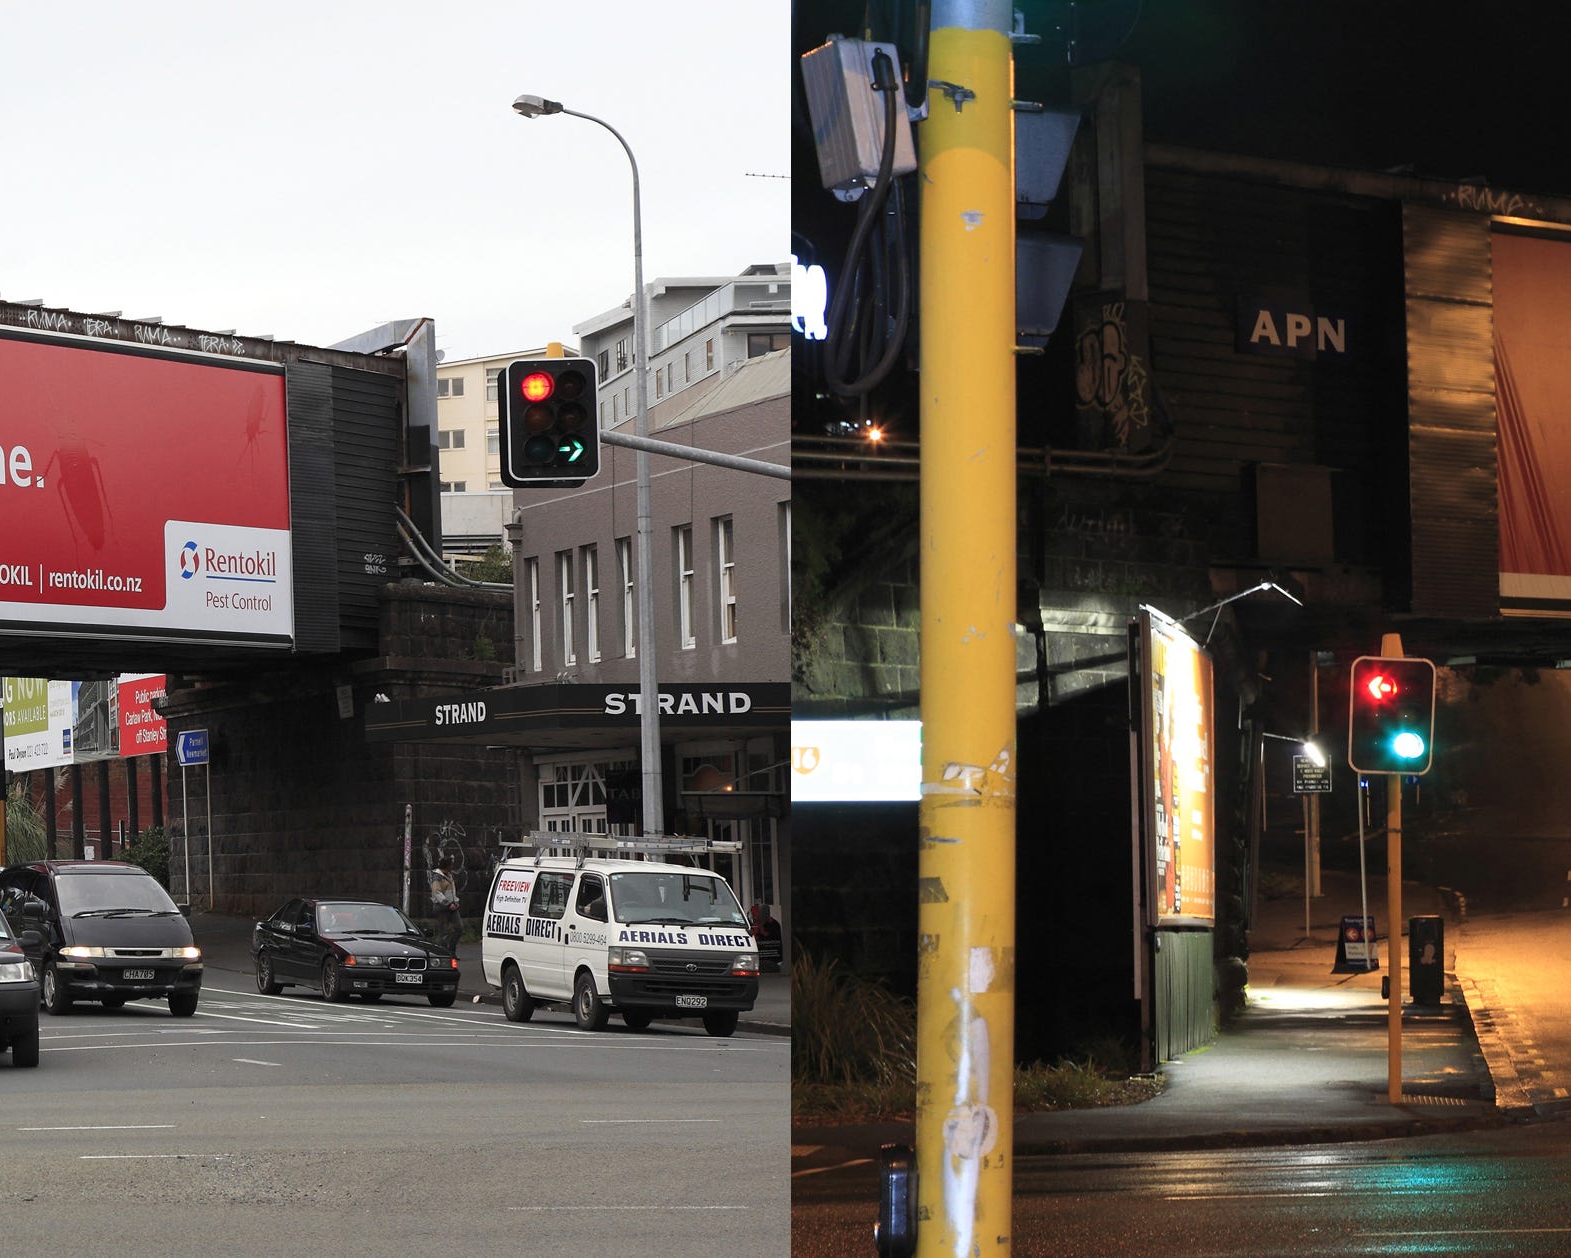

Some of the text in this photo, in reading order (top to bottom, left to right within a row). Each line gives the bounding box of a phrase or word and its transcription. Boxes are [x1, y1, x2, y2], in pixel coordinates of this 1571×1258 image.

[1250, 310, 1345, 353] APN
[206, 547, 277, 577] Rentokil
[48, 569, 142, 593] rentokil.co.nz
[206, 591, 272, 612] Pest Control
[135, 688, 149, 705] Public
[604, 692, 752, 716] STRAND
[17, 704, 46, 723] AVAILABLE
[435, 702, 486, 725] STRAND
[792, 748, 817, 770] 16
[499, 880, 531, 893] FREEVIEW
[496, 895, 504, 904] High
[504, 895, 521, 904] Definition
[487, 914, 557, 939] AERIALS DIRECT
[619, 930, 752, 948] AERIALS DIRECT
